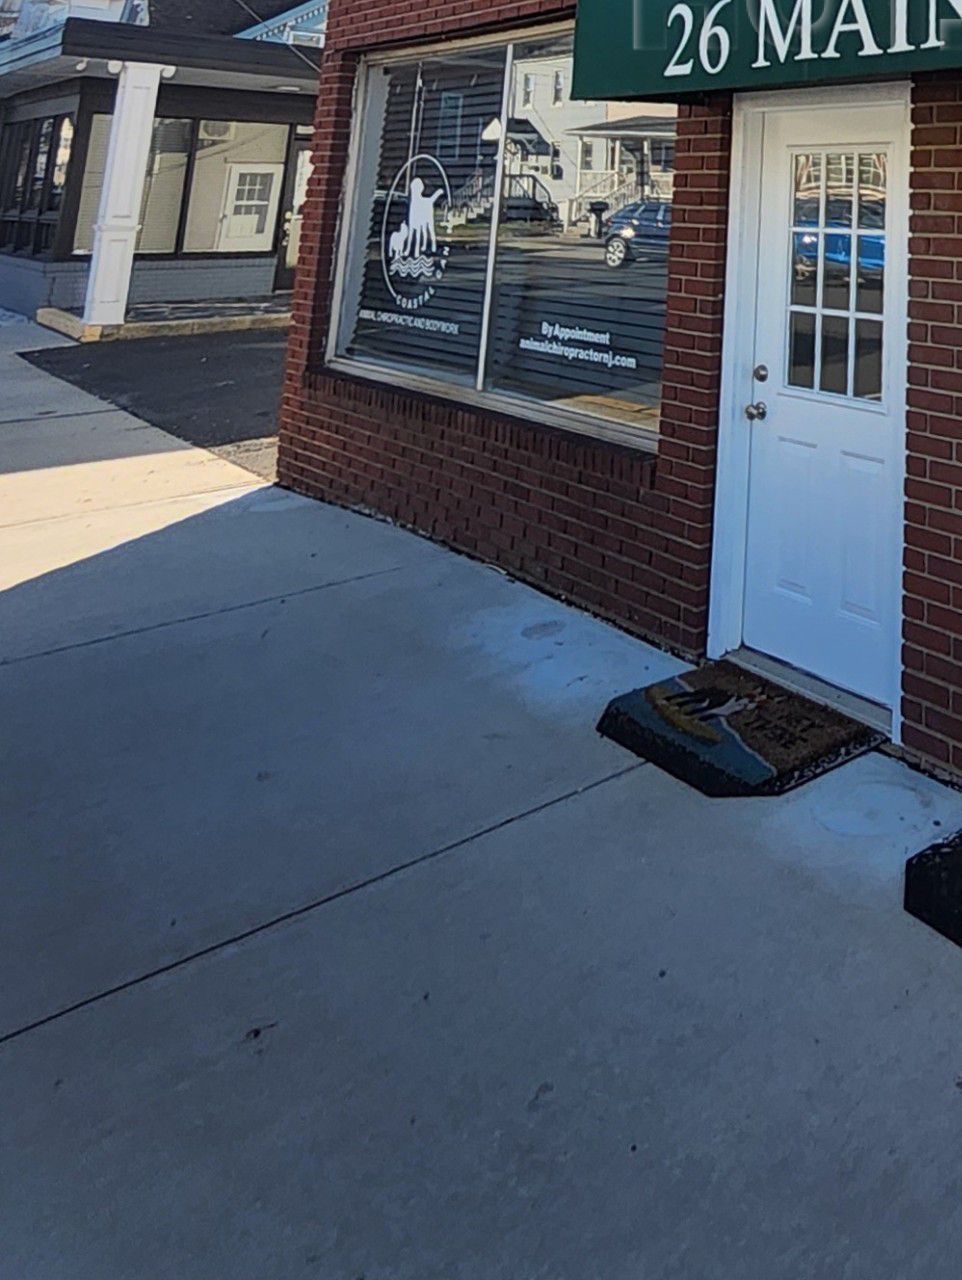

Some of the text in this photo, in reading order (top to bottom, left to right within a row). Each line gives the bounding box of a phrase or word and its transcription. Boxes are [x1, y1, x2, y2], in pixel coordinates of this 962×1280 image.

[395, 286, 436, 309] COASTAL
[541, 321, 611, 345] By Appointment
[519, 337, 637, 369] animalchiropractornj.com
